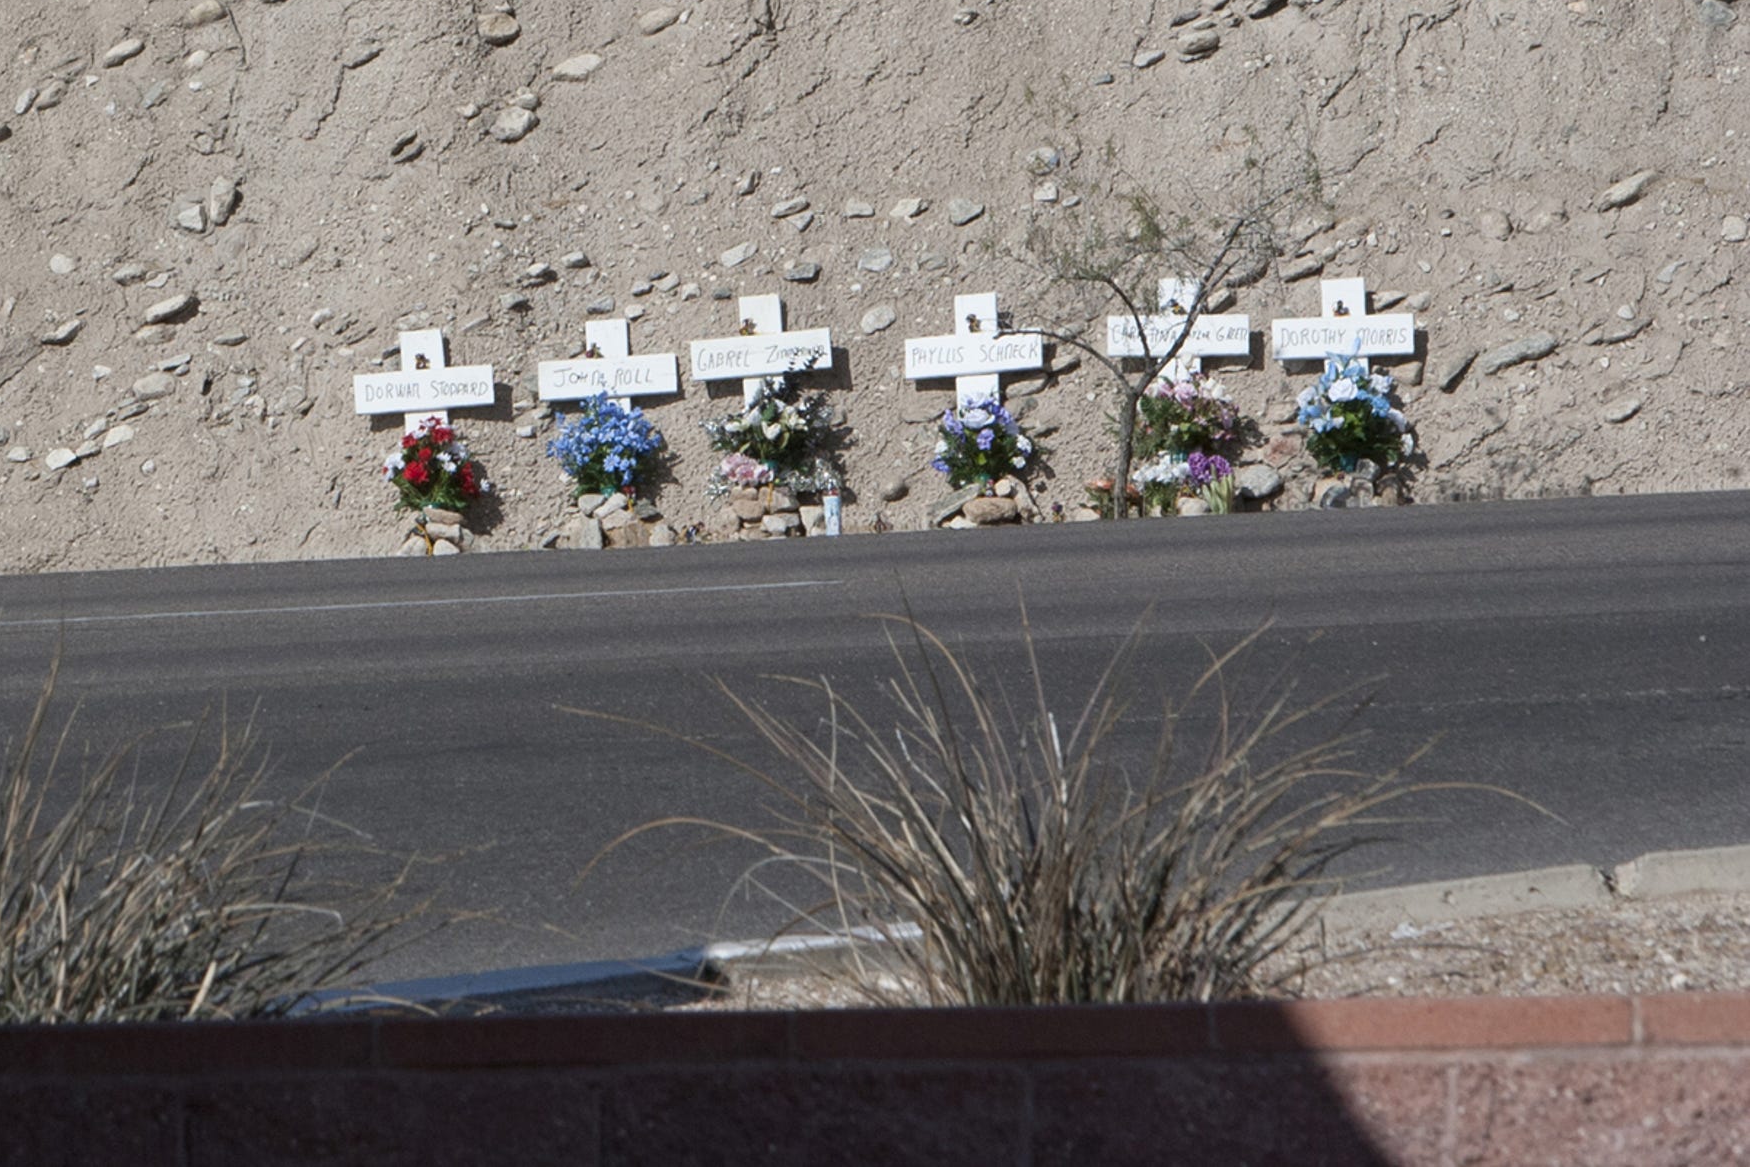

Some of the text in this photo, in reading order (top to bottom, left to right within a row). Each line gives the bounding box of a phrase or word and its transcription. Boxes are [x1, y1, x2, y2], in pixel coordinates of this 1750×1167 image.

[1280, 327, 1408, 349] DOROTHY MORRIS
[911, 346, 965, 368] PHYLLIS
[613, 368, 654, 387] ROLL
